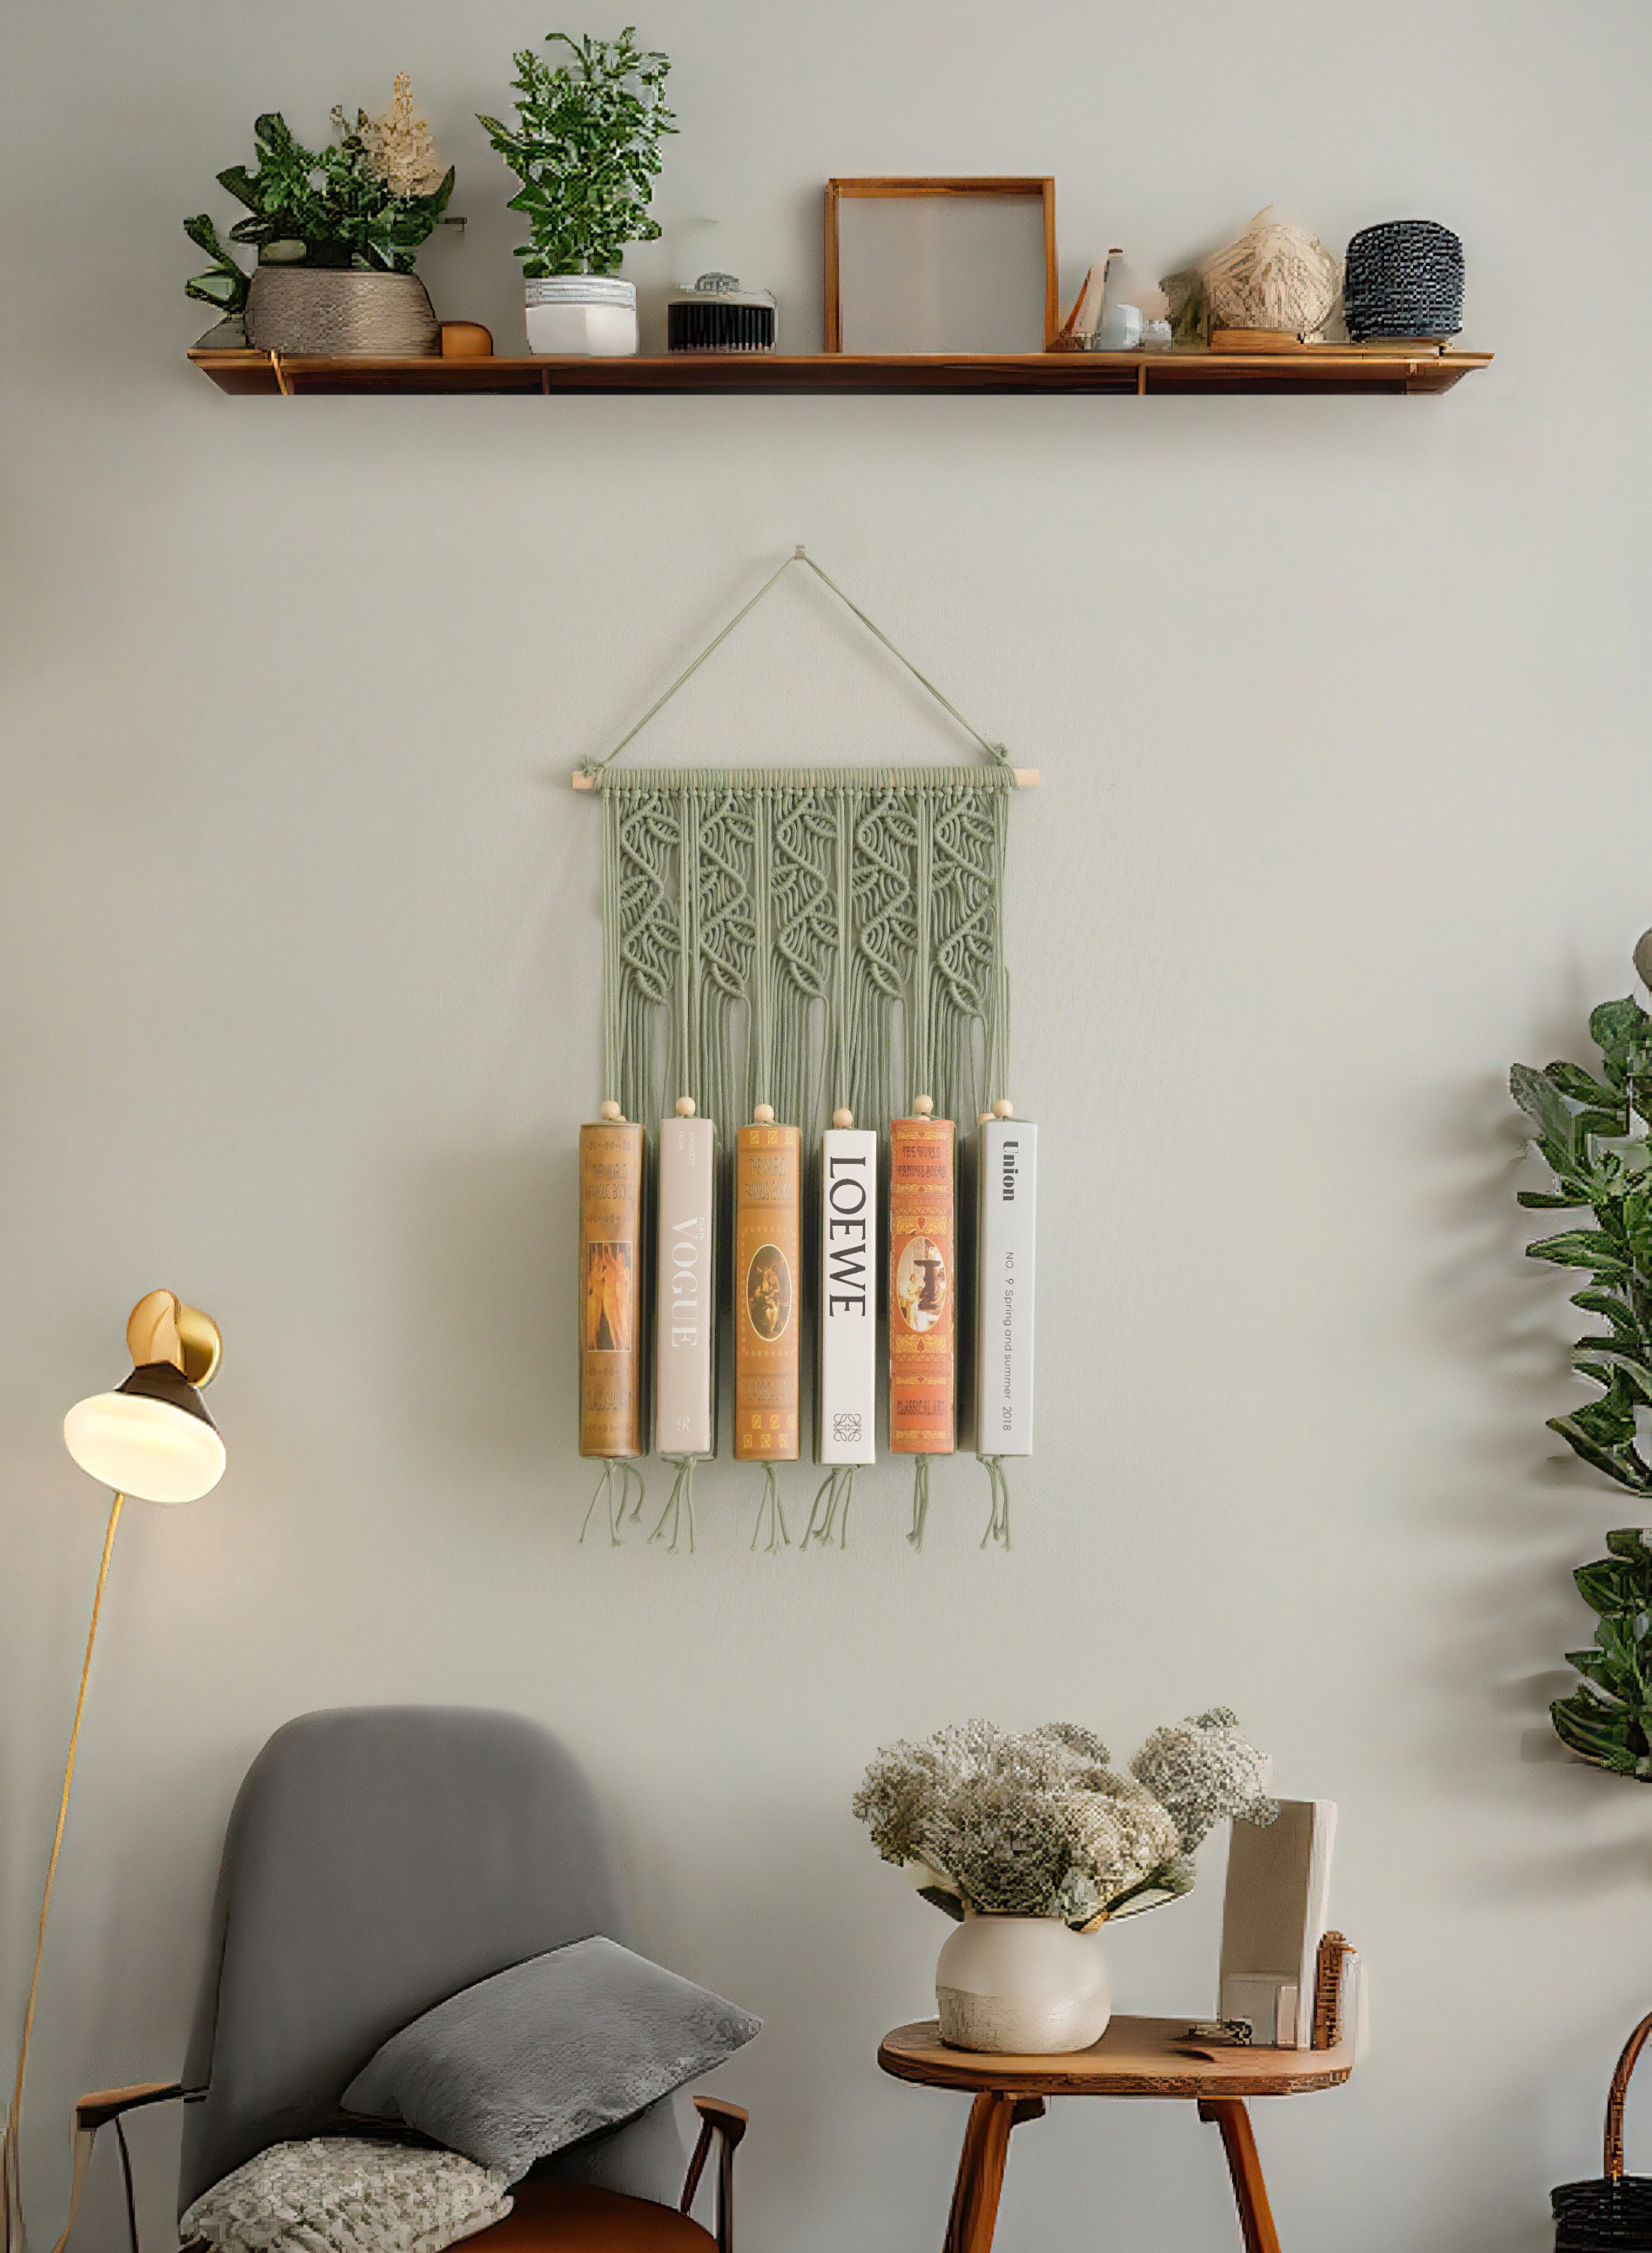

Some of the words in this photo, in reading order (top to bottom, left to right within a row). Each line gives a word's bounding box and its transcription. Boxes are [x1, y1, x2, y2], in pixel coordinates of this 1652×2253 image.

[1002, 1141, 1018, 1201] Union
[830, 1157, 867, 1317] LOEWE
[671, 1215, 698, 1347] VOGUE
[1003, 1290, 1014, 1326] Spring
[1002, 1407, 1012, 1431] 2018
